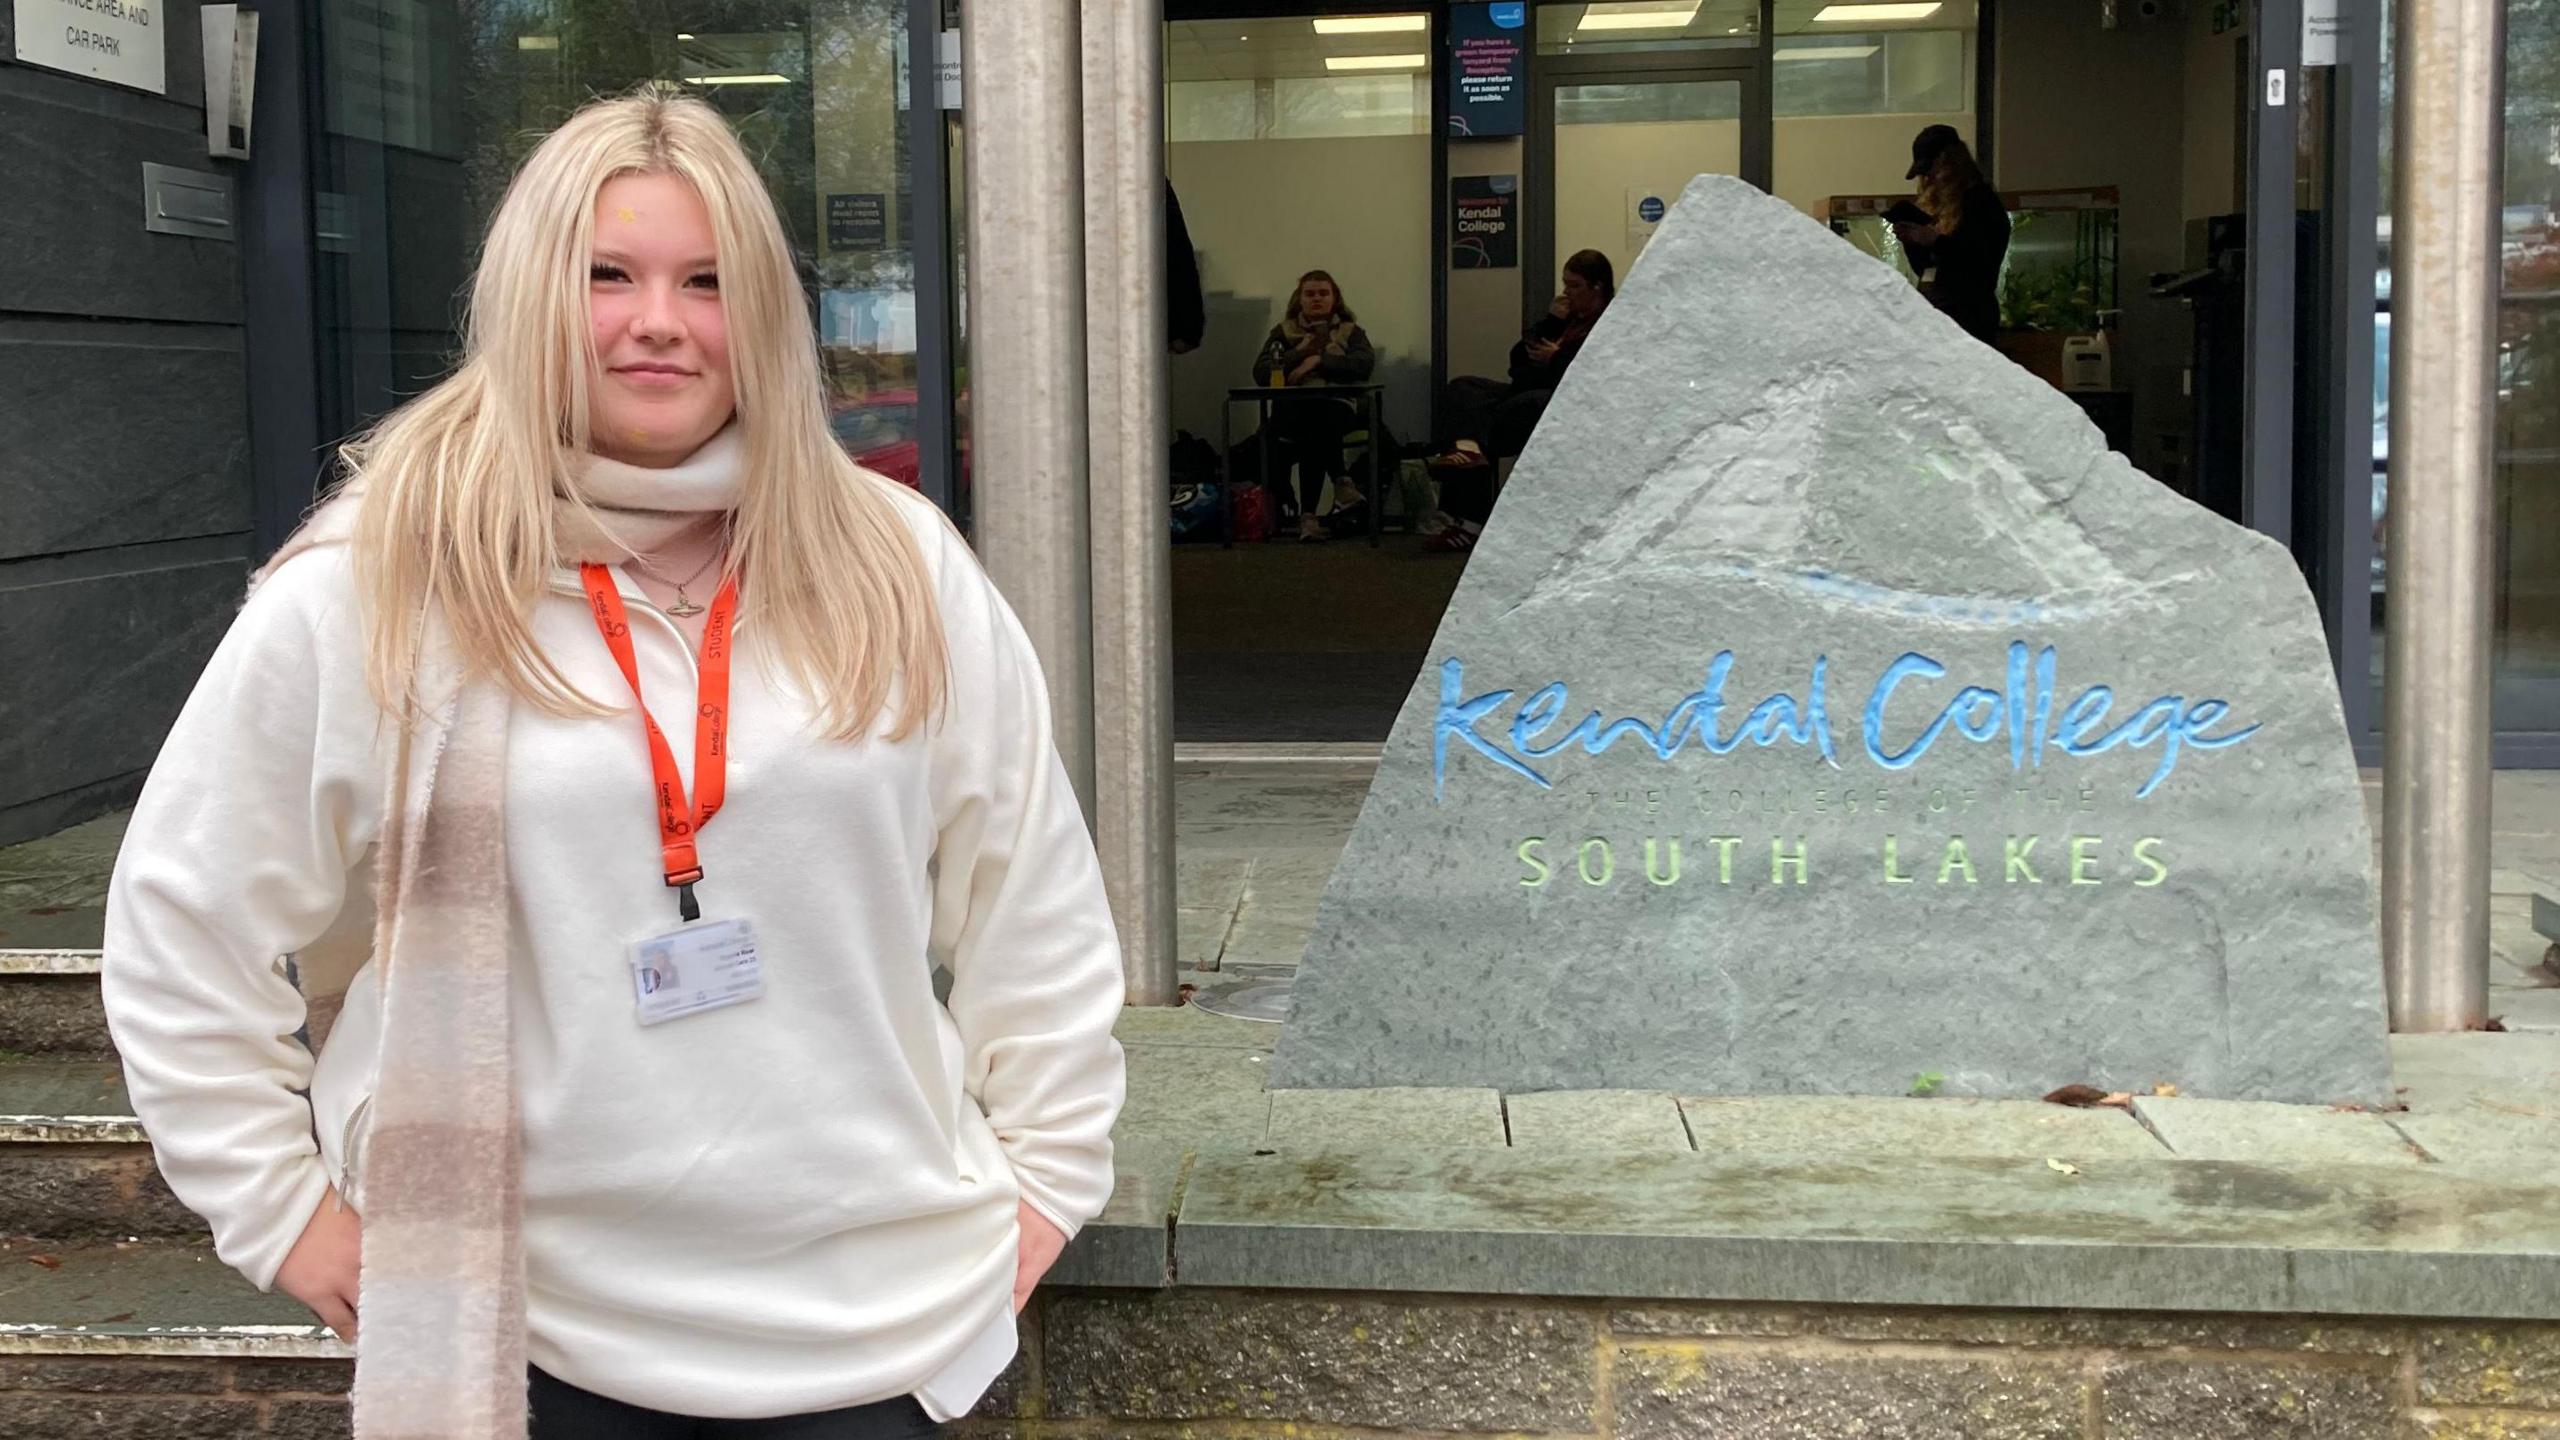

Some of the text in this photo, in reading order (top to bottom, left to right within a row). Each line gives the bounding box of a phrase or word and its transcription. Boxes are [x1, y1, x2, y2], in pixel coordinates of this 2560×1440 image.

[96, 0, 126, 20] AREA
[128, 5, 150, 27] AND
[66, 26, 121, 56] CAR PARK
[1458, 206, 1502, 219] Kendal
[1458, 220, 1505, 234] College
[708, 610, 726, 659] STUDENT
[1433, 640, 2264, 804] Kendal College
[1586, 788, 2095, 815] THE COLLEGE OF THE
[1518, 834, 2168, 888] SOUTH LAKES
